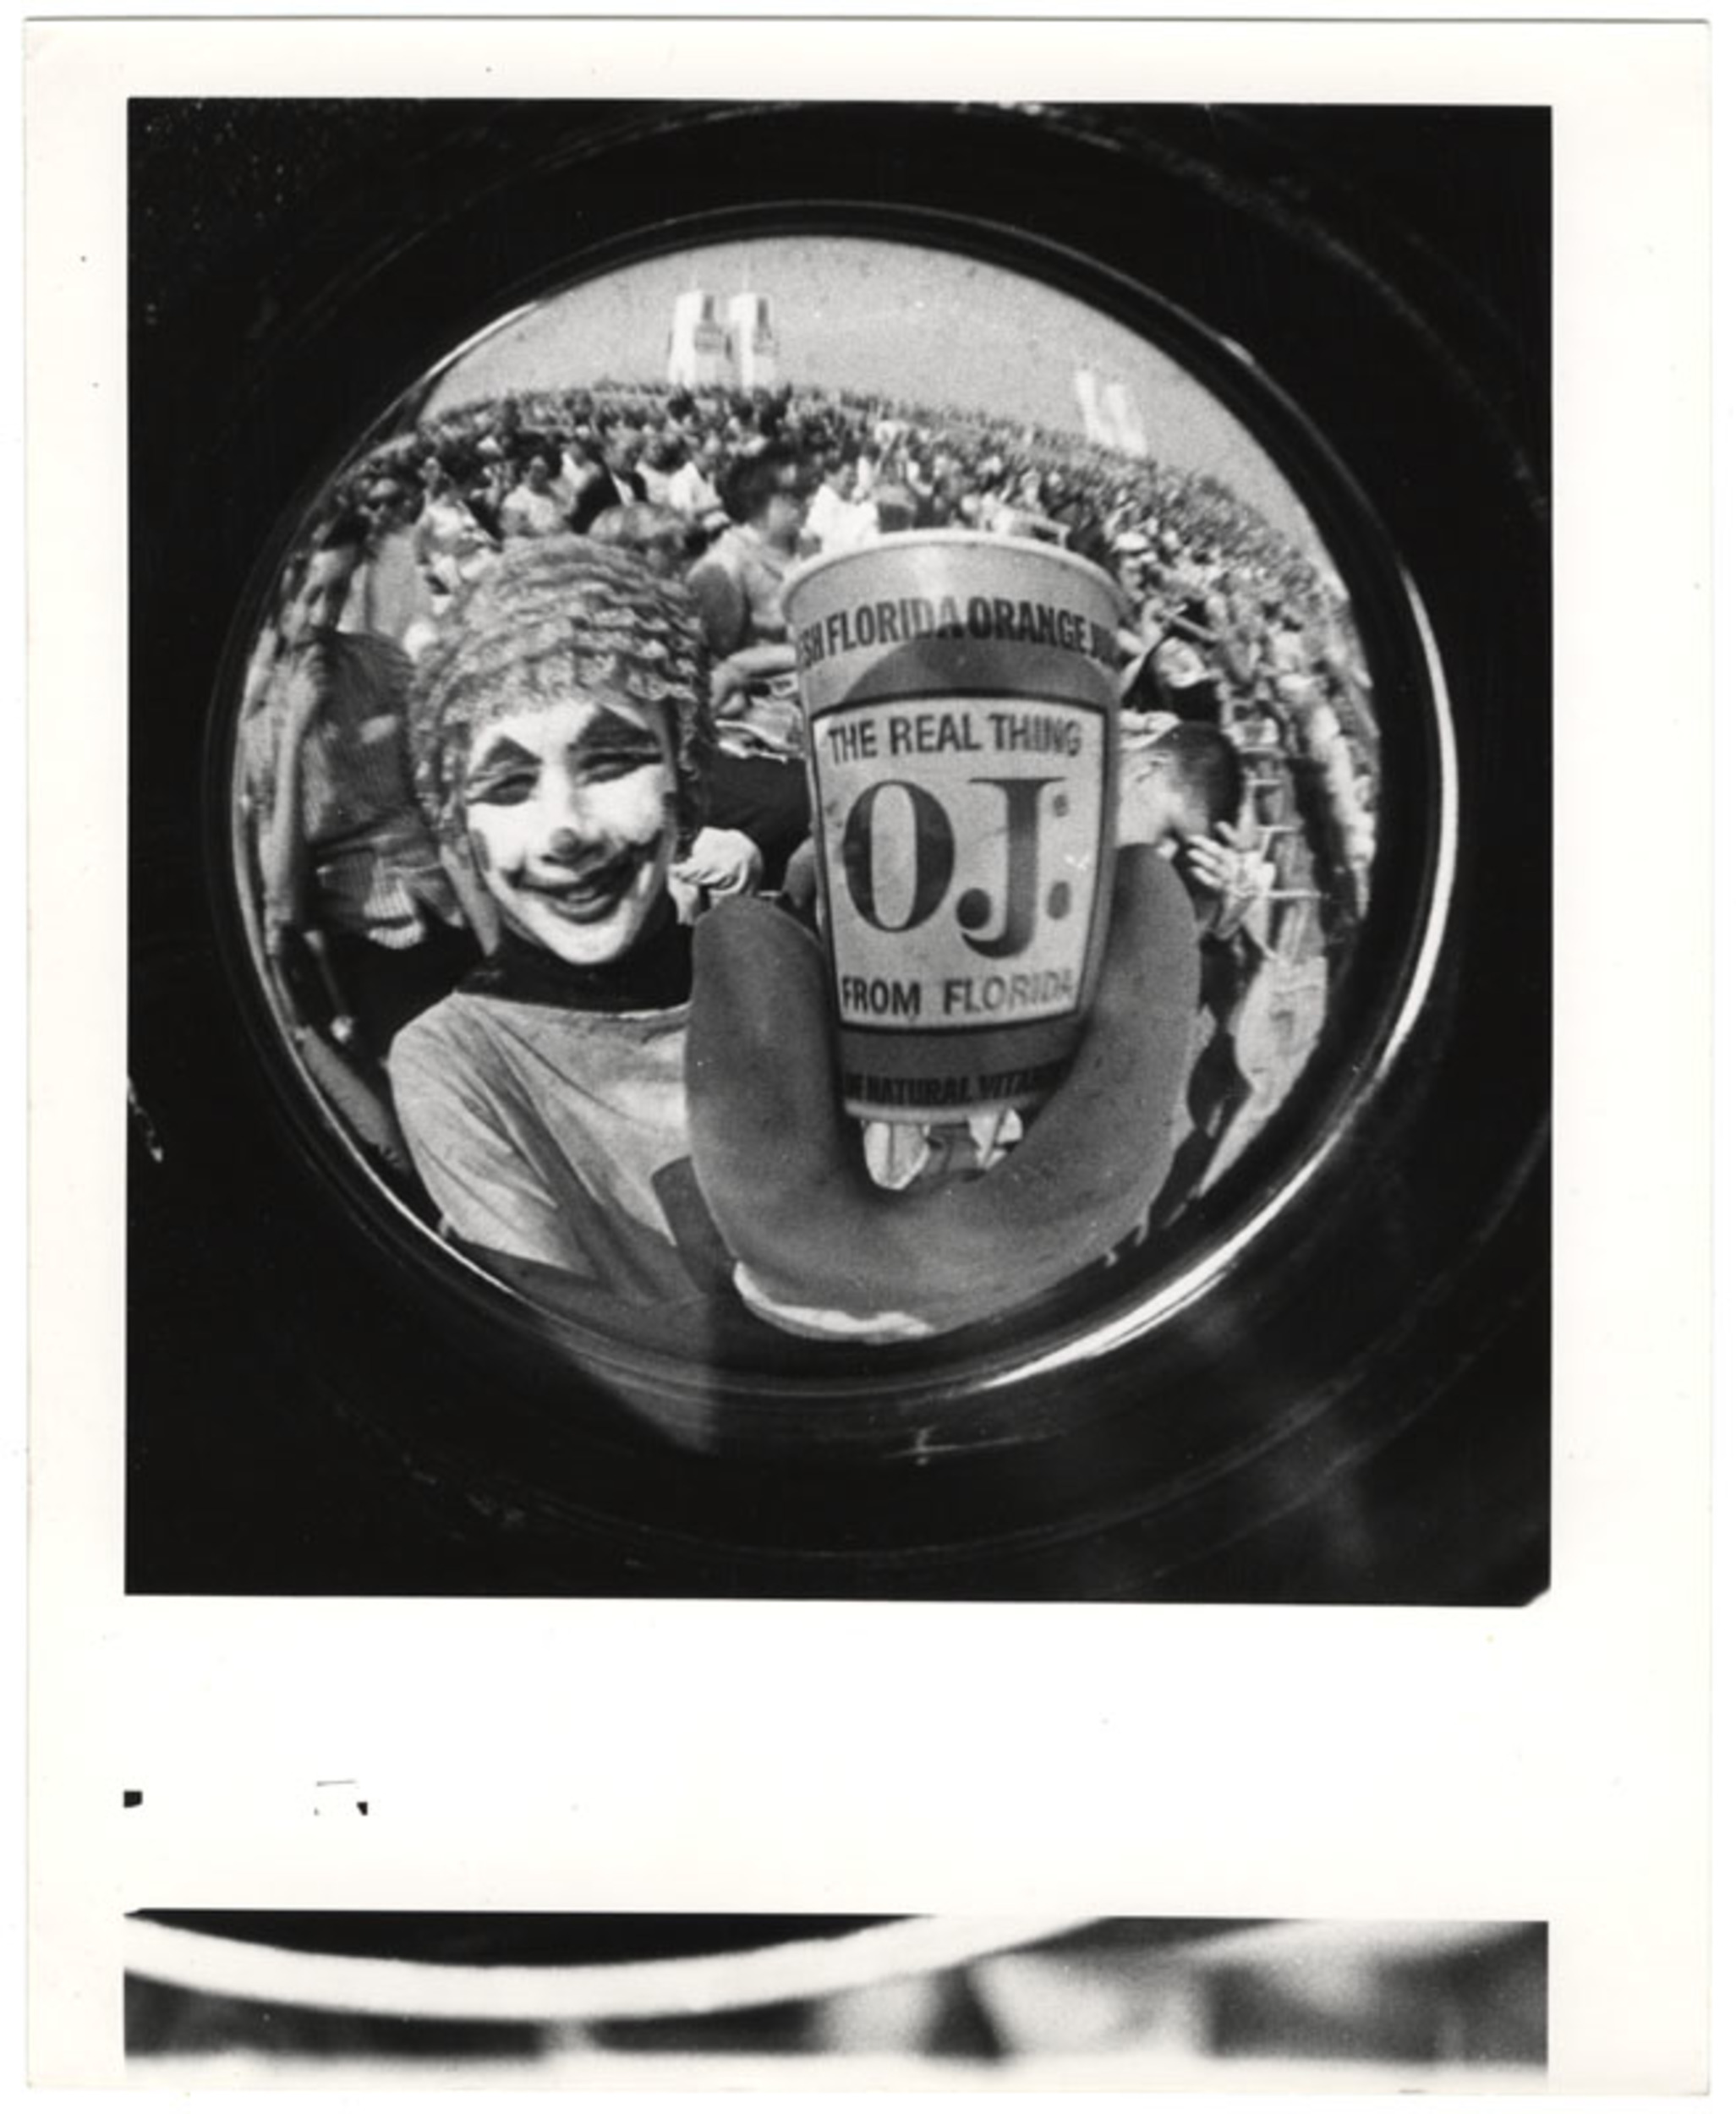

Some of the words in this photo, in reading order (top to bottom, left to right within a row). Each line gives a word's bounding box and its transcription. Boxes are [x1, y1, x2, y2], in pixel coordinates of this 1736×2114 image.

[827, 594, 964, 655] FLORIDA
[967, 596, 1087, 653] ORANGE
[827, 719, 879, 764] THE
[889, 713, 981, 756] REAL
[988, 713, 1082, 758] THING
[842, 976, 921, 1015] FROM
[943, 970, 1074, 1015] FLORIDA
[866, 1075, 972, 1106] NATURAL
